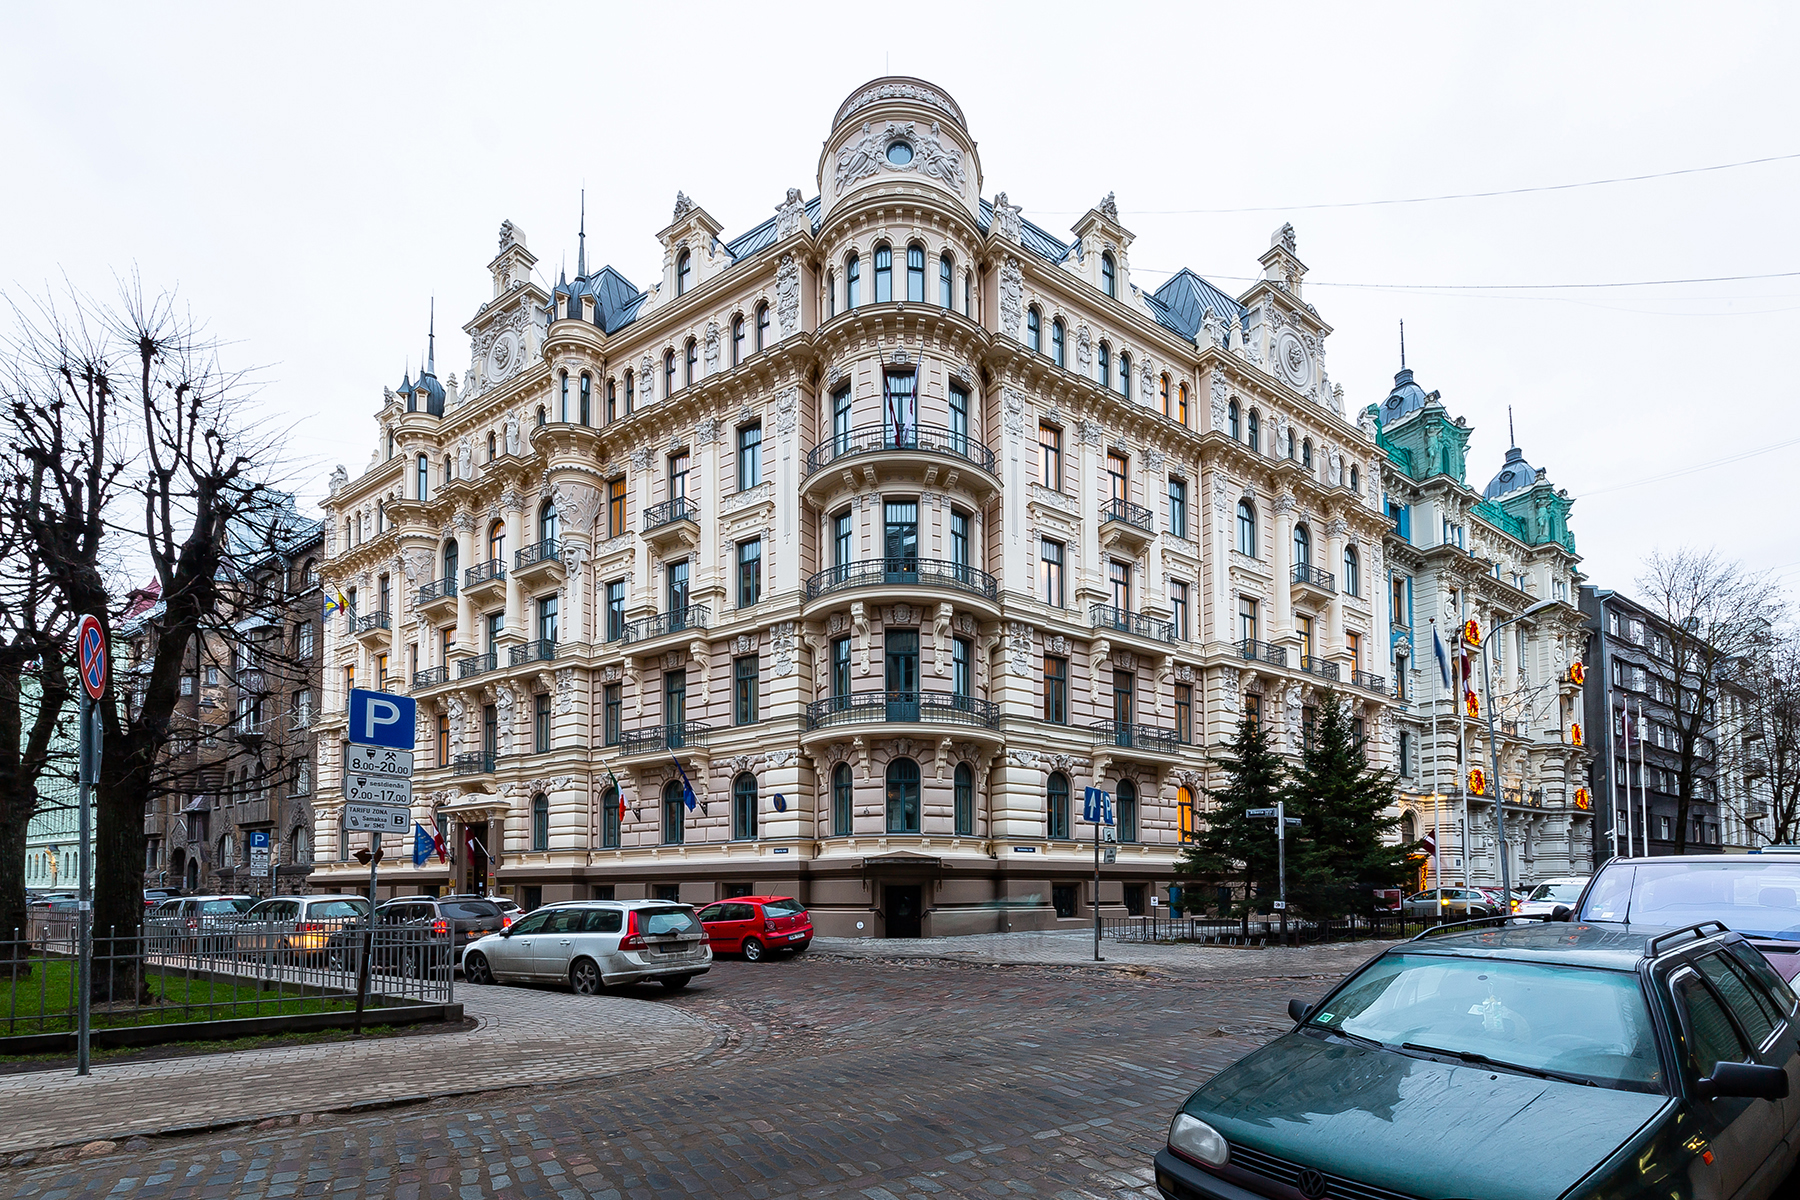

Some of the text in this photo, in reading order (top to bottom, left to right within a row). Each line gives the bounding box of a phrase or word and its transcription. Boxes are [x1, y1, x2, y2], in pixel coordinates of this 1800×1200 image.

[365, 698, 400, 738] P
[352, 758, 409, 775] 8.00-20.00
[349, 806, 371, 814] TARIFU
[1105, 795, 1111, 820] P
[394, 815, 404, 825] B
[254, 834, 265, 846] P
